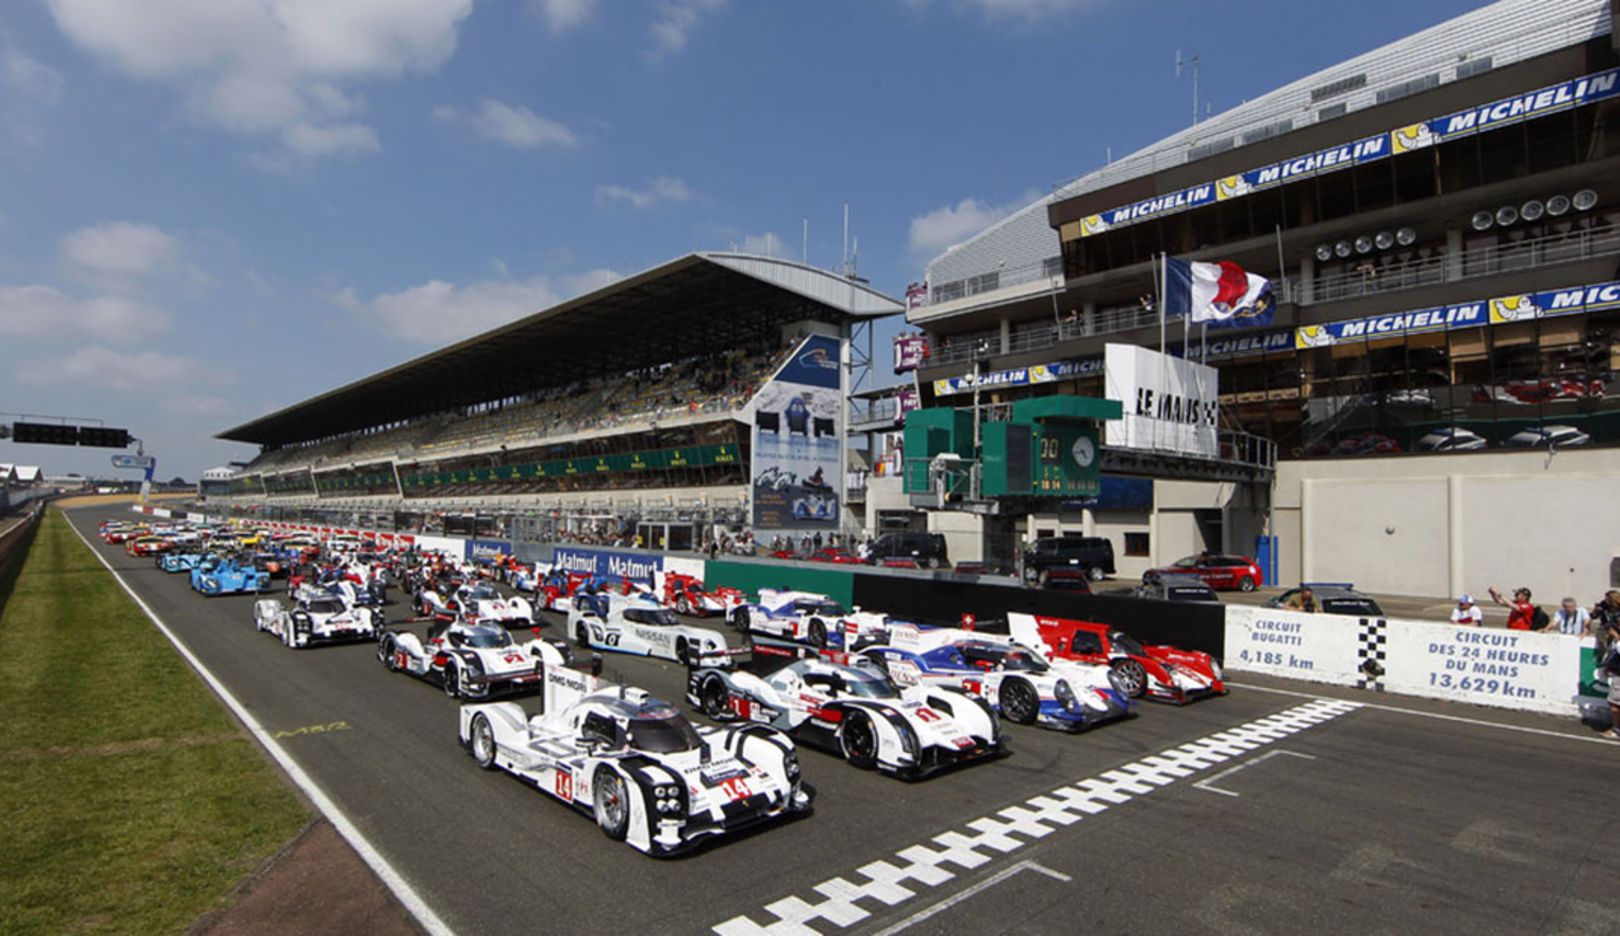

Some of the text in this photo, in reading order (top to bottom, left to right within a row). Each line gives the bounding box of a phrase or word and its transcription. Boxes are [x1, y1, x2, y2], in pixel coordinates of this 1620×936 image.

[1446, 73, 1617, 132] MICHELIN
[1257, 138, 1385, 184] MICHELIN
[1112, 186, 1210, 223] MICHELIN
[1551, 285, 1620, 308] MIC
[1341, 305, 1480, 337] MICHELIN
[957, 369, 1026, 389] MCHELIN
[1058, 359, 1105, 376] MICH
[1136, 387, 1153, 417] LE
[557, 551, 597, 573] Matmut
[1256, 620, 1302, 633] CIRCUIT
[1251, 632, 1302, 646] BUGATTI
[1456, 631, 1519, 647] CIRCUIT
[1240, 649, 1314, 670] 4,185 km
[1429, 643, 1550, 666] DES 24 HEURES
[1445, 659, 1519, 678] DU MANS
[1429, 672, 1536, 698] 13,629 km
[558, 773, 571, 800] 14
[719, 778, 751, 801] 14
